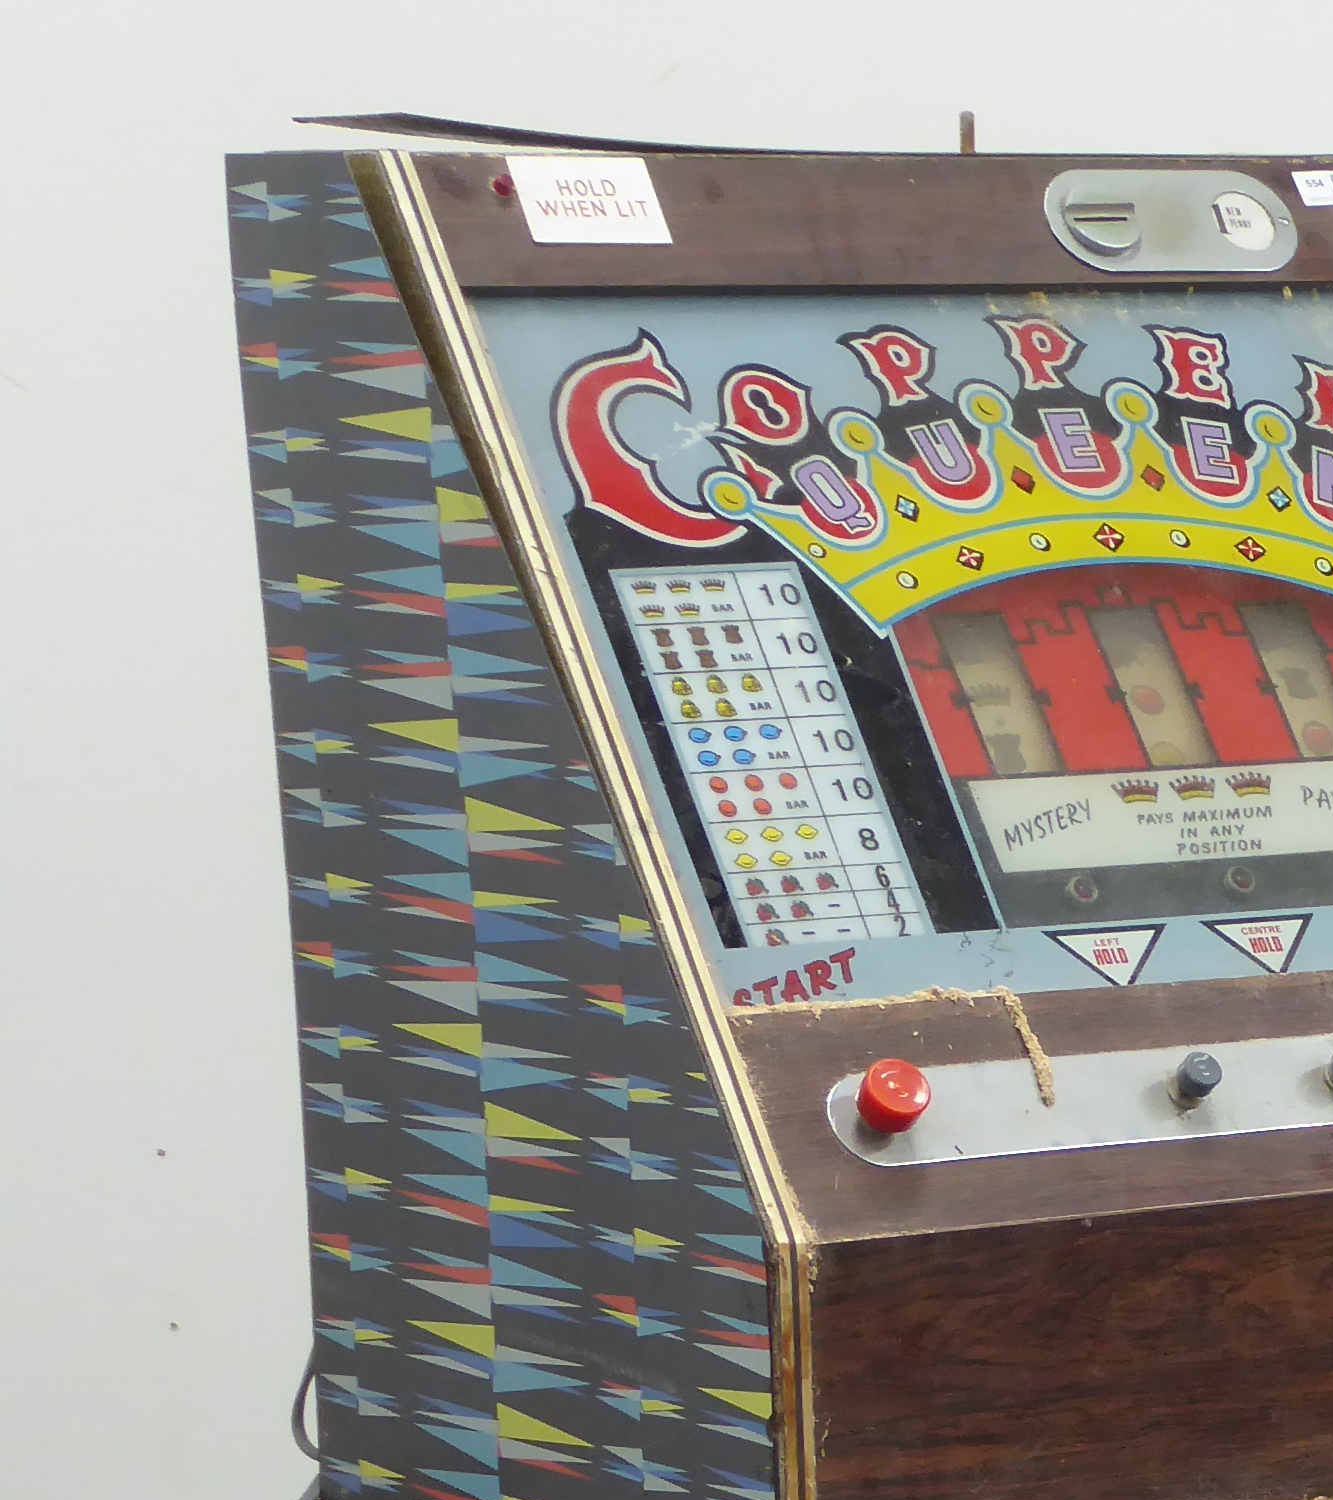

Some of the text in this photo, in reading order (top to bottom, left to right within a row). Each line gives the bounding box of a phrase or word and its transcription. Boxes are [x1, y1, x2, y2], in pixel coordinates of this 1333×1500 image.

[555, 178, 617, 197] HOLD
[535, 199, 649, 218] WHEN LIT
[712, 582, 802, 613] BAR 10
[730, 631, 819, 662] BAR 10
[749, 679, 837, 712] BAR 10
[767, 728, 855, 761] BAR 10
[785, 776, 874, 810] BAR 10
[1003, 798, 1092, 852] MYSTERY
[1136, 805, 1273, 825] PAYS MAXIMUM
[1180, 824, 1245, 839] IN ANY
[804, 827, 881, 861] BAR 8
[1176, 839, 1263, 856] POSITION
[875, 864, 891, 888] 6
[887, 888, 901, 915] 4
[894, 915, 911, 938] 2
[1240, 924, 1282, 936] CENTRE
[1093, 937, 1121, 947] LEFT
[1248, 936, 1284, 954] HOLD
[1092, 947, 1129, 966] HOLD
[732, 946, 857, 1007] START
